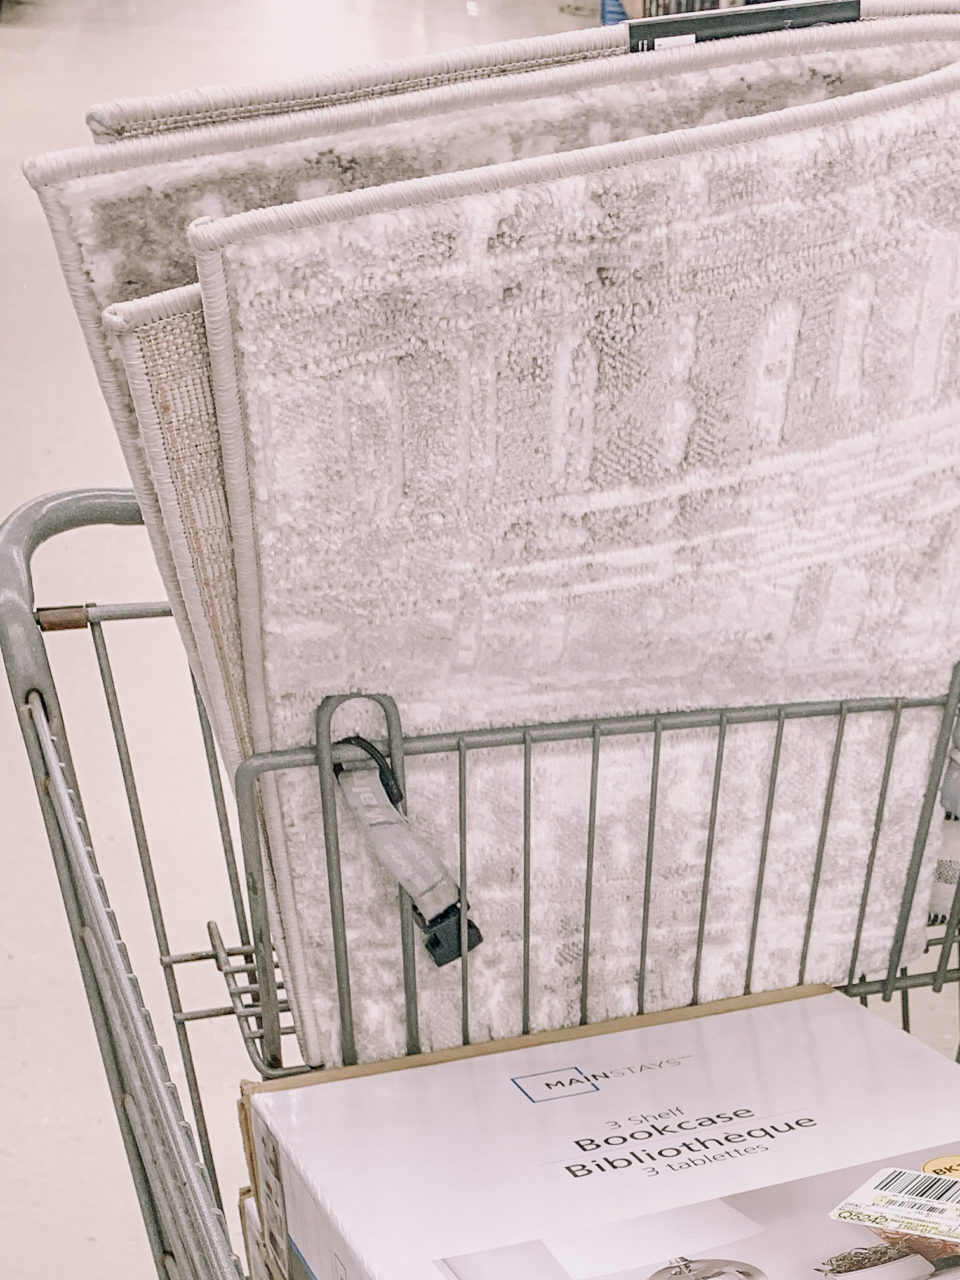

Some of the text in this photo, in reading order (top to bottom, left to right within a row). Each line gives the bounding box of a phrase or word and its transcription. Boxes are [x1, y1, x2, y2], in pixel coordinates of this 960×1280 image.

[544, 1058, 681, 1090] MAINSTAYS
[573, 1107, 755, 1152] Bookcase
[605, 1106, 685, 1130] 3 Shelf
[564, 1116, 818, 1178] Bibliothèque
[643, 1144, 770, 1177] 3 tablettes
